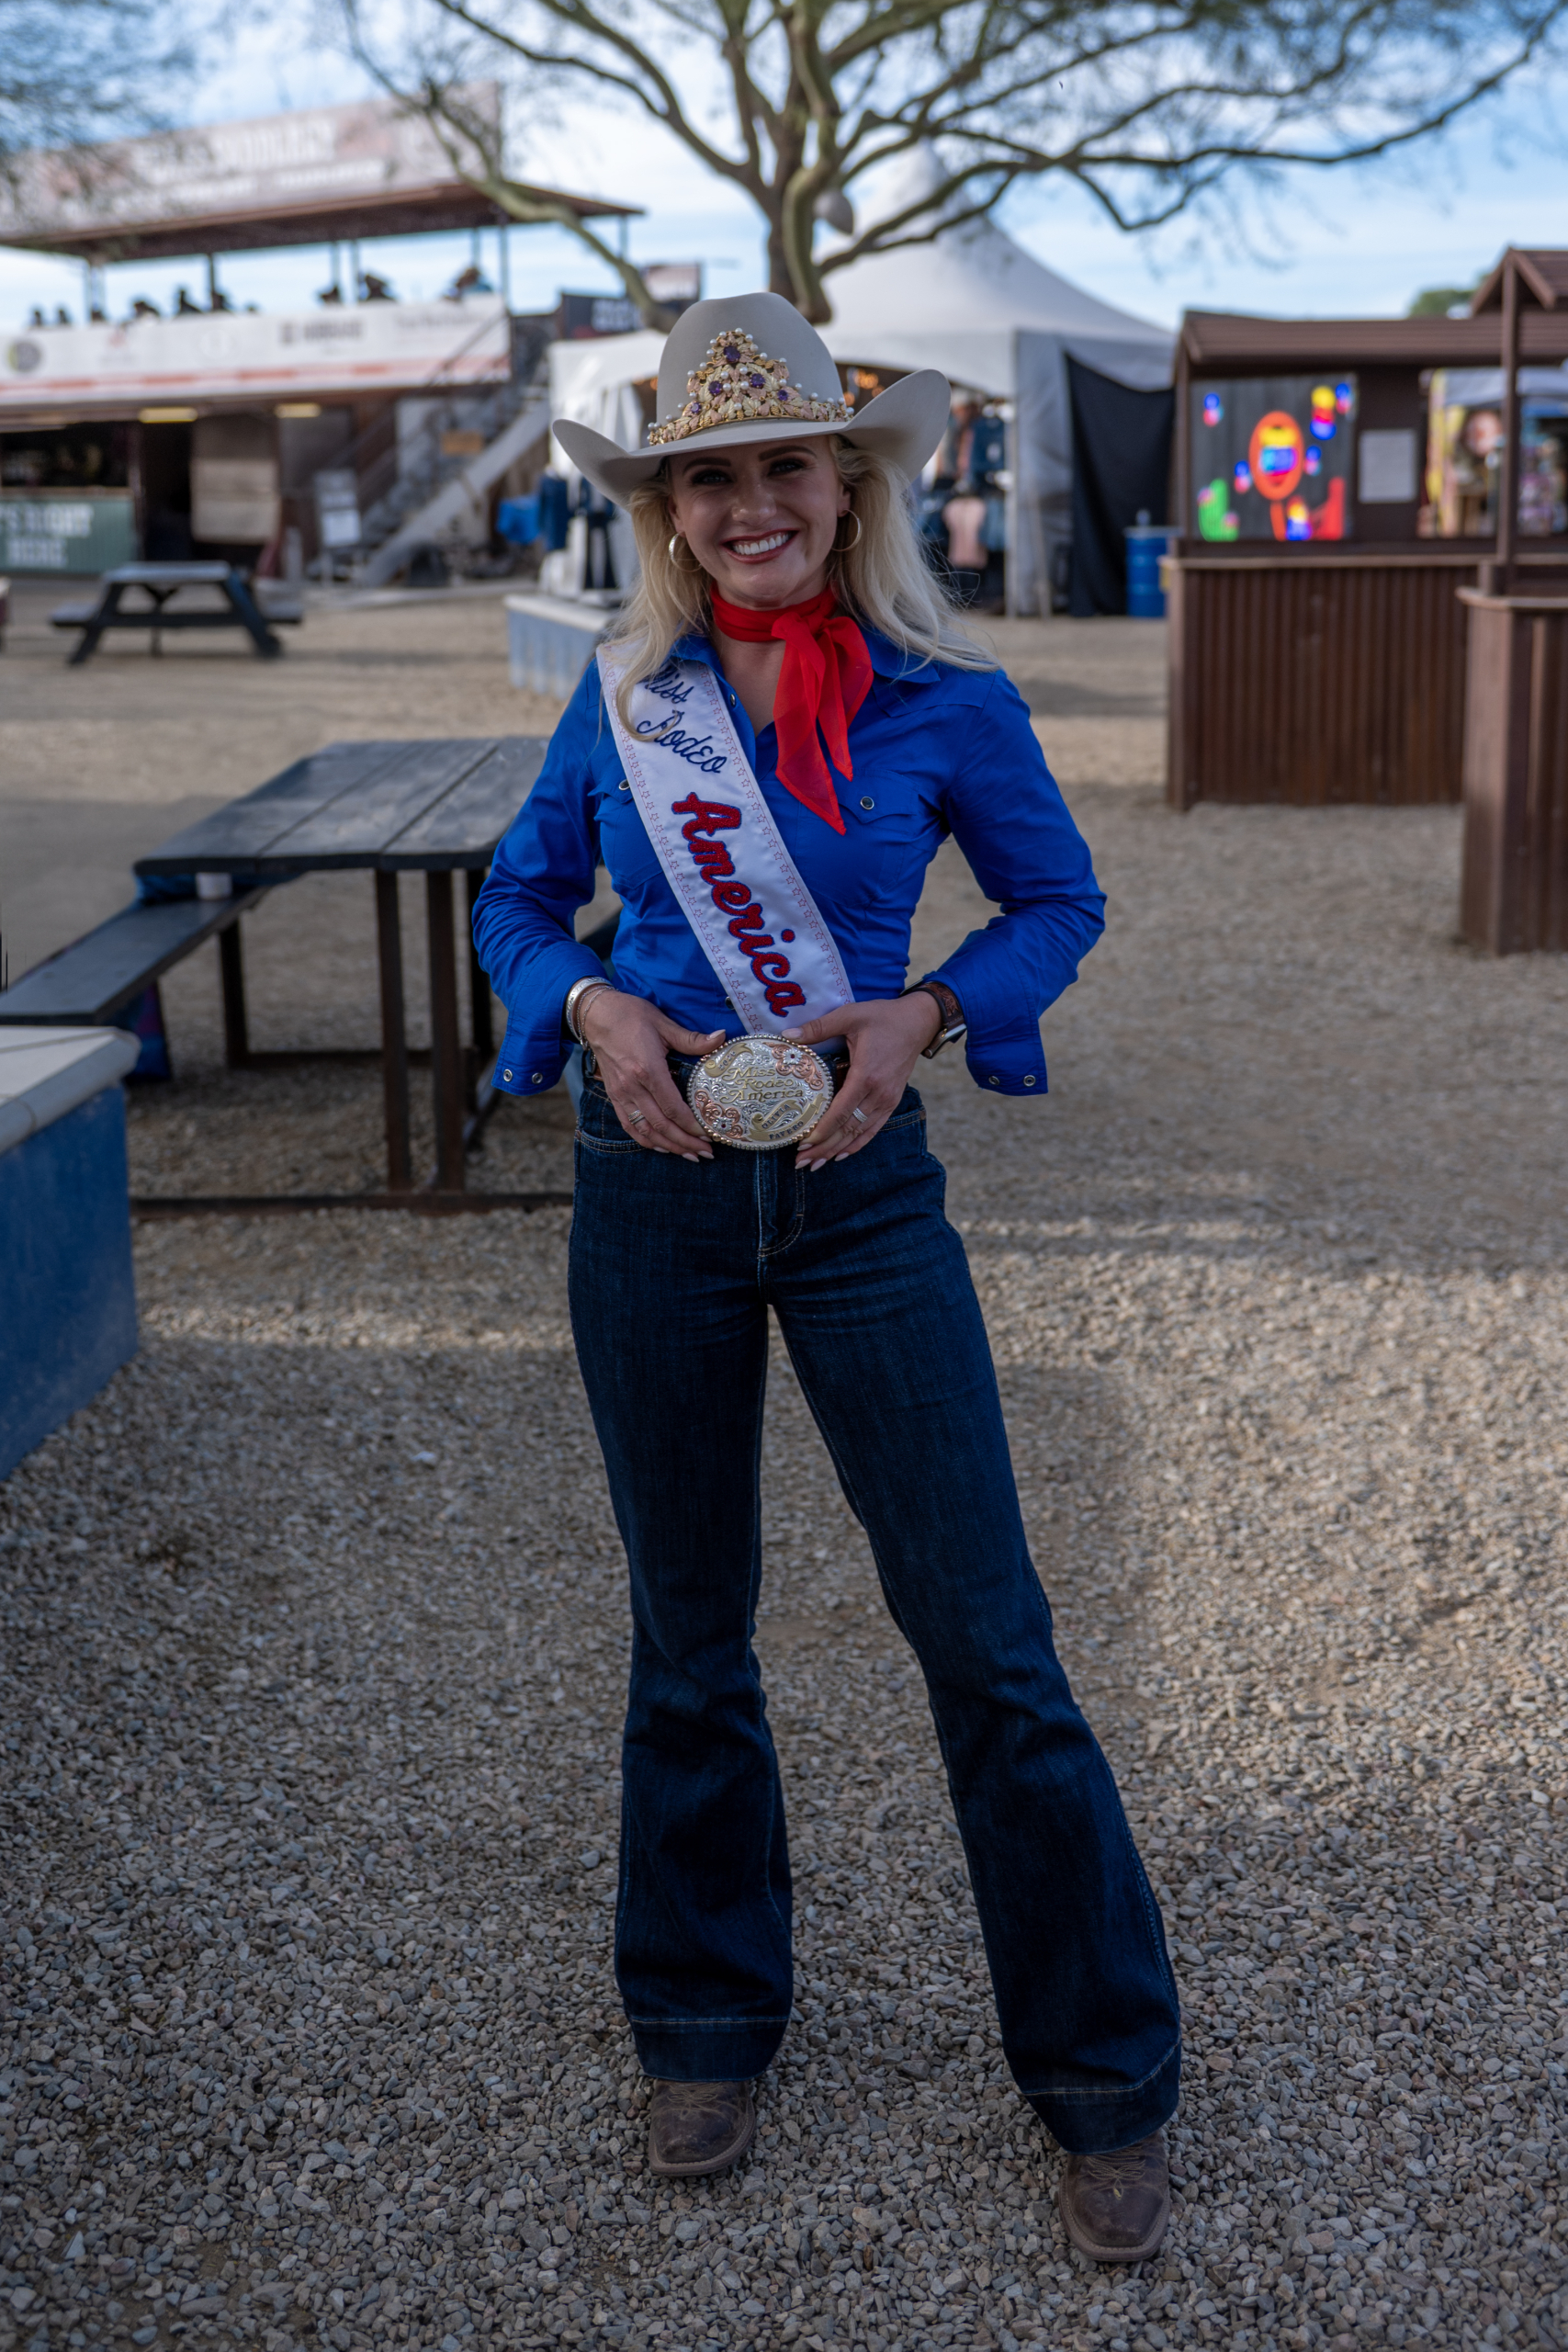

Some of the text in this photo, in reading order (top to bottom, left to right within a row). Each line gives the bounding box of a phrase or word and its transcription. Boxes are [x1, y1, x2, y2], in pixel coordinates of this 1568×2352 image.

[671, 792, 807, 1018] America
[721, 1066, 776, 1081] Miss
[735, 1077, 794, 1092] Rodeo
[719, 1087, 804, 1103] America
[761, 1103, 791, 1129] OLIVIA
[769, 1121, 804, 1140] FAVERO
